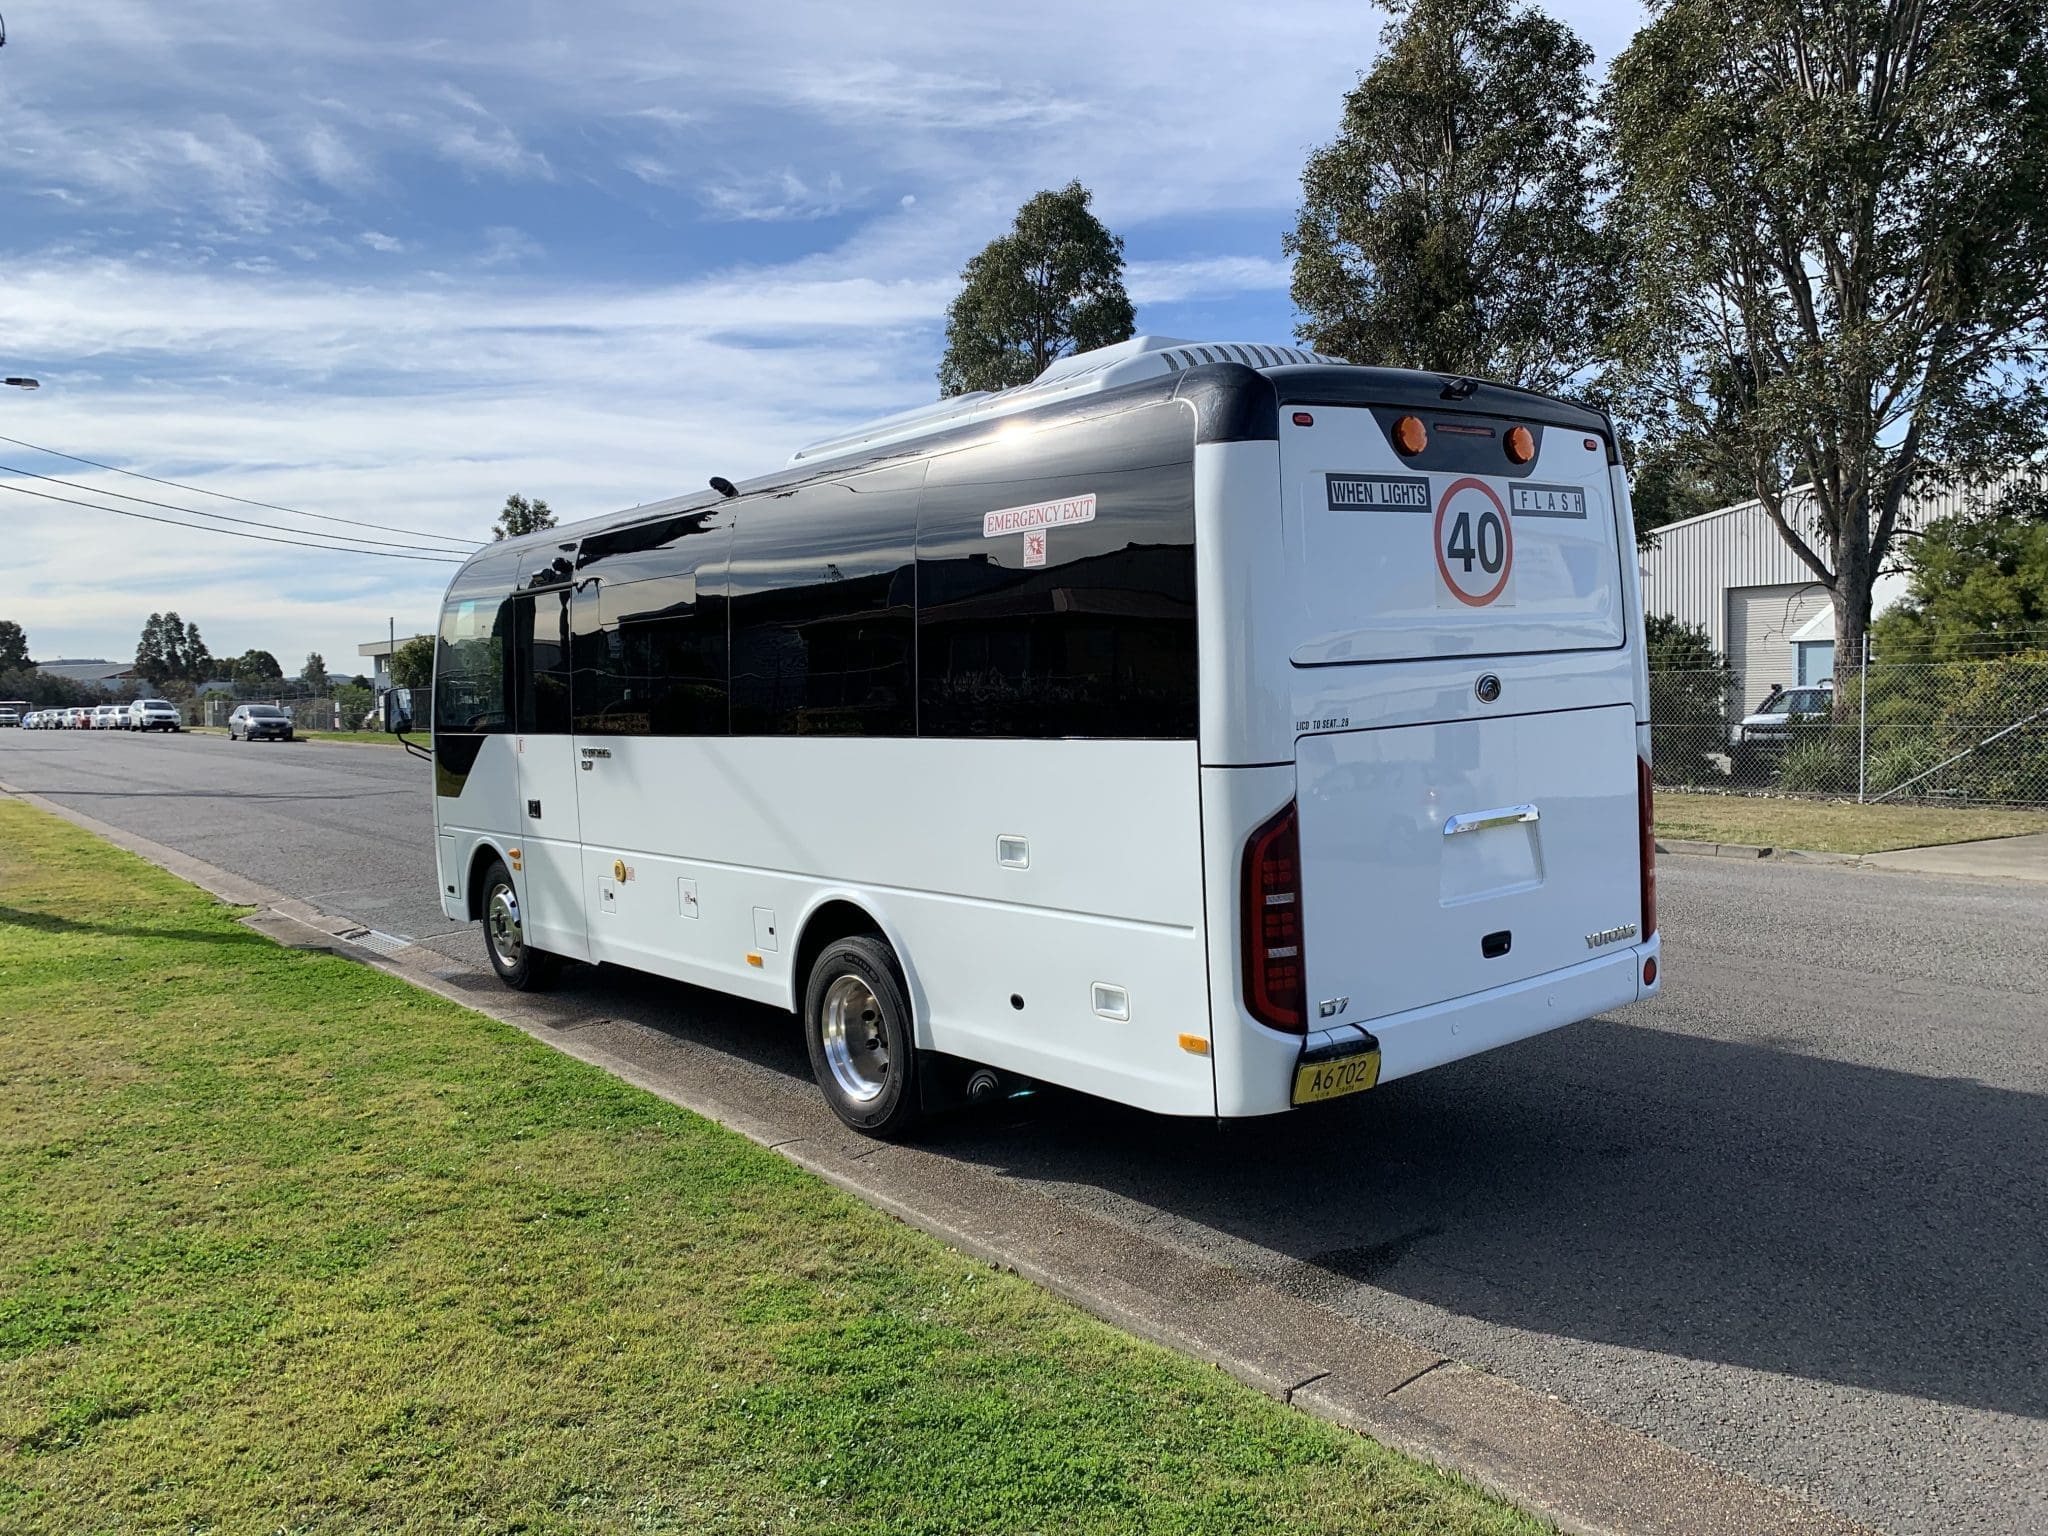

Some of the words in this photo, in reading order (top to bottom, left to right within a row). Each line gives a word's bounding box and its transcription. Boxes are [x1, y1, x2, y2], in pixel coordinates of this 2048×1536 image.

[1331, 482, 1373, 504] WHEN
[1380, 483, 1426, 505] LIGHTS
[1521, 490, 1582, 513] FLASH
[987, 504, 1061, 532] EMERGENCY
[1063, 499, 1093, 520] EXIT
[1447, 511, 1504, 574] 40
[1312, 719, 1321, 730] TO
[1585, 923, 1637, 949] YUTONG
[1319, 996, 1349, 1018] D7
[1311, 1060, 1367, 1092] A6702
